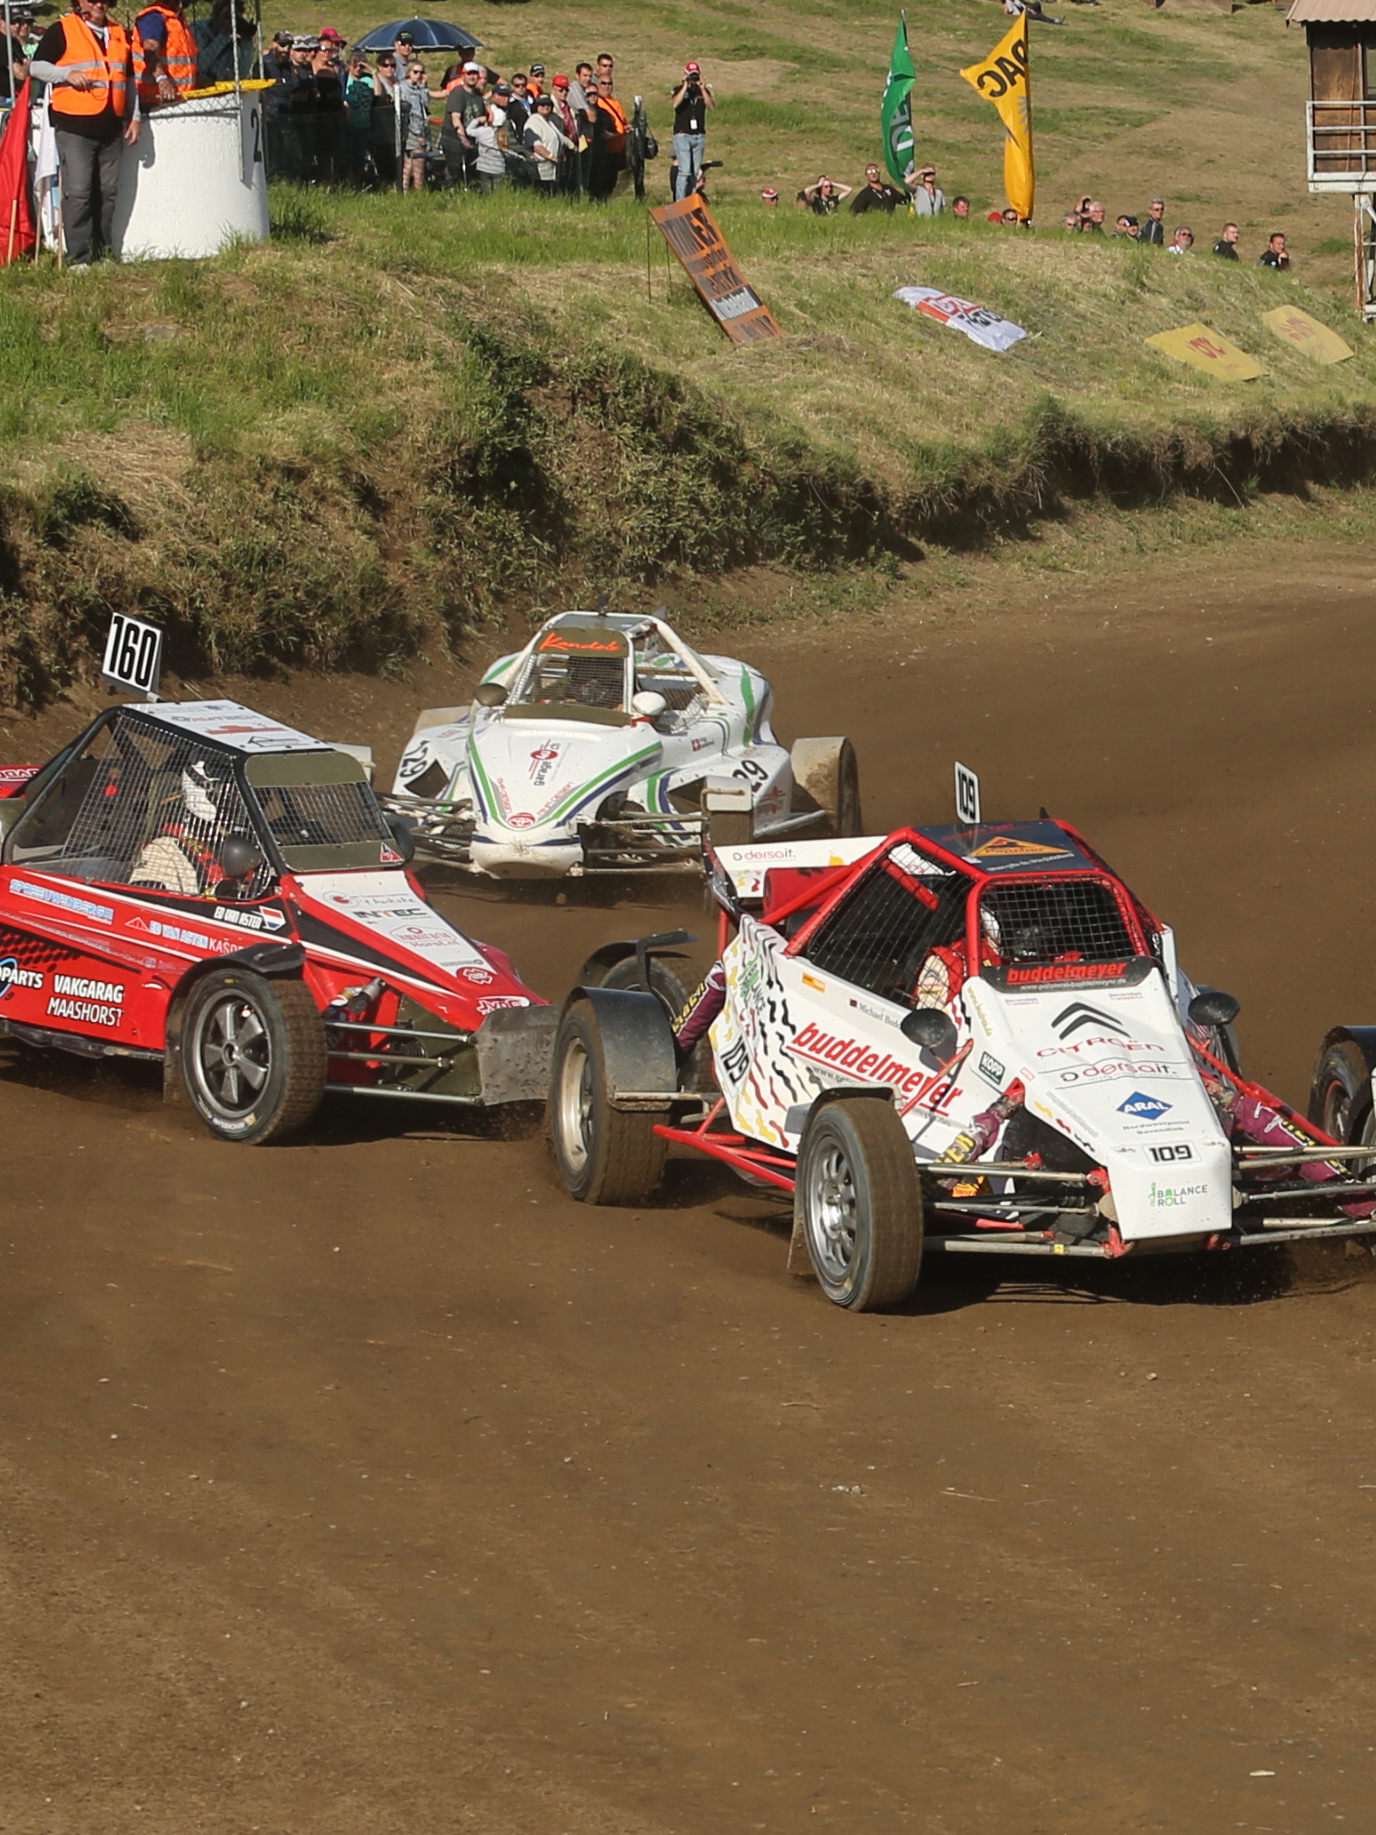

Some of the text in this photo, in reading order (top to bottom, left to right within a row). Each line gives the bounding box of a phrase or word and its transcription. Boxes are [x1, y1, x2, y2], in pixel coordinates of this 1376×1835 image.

[103, 615, 157, 687] 160
[732, 759, 769, 794] 29
[957, 769, 977, 820] 109
[0, 966, 44, 989] PARTS
[1007, 962, 1128, 985] buddelmeyer
[47, 996, 124, 1027] MAASHORST
[858, 1002, 884, 1022] Michael
[1036, 1036, 1165, 1058] CITROËN
[791, 1022, 963, 1109] buddelmeyer
[982, 1053, 1003, 1078] KOPP
[1124, 1101, 1169, 1114] ARAL
[1148, 1145, 1193, 1162] 109
[1157, 1184, 1208, 1198] BALANCE
[1157, 1196, 1186, 1207] ROLL
